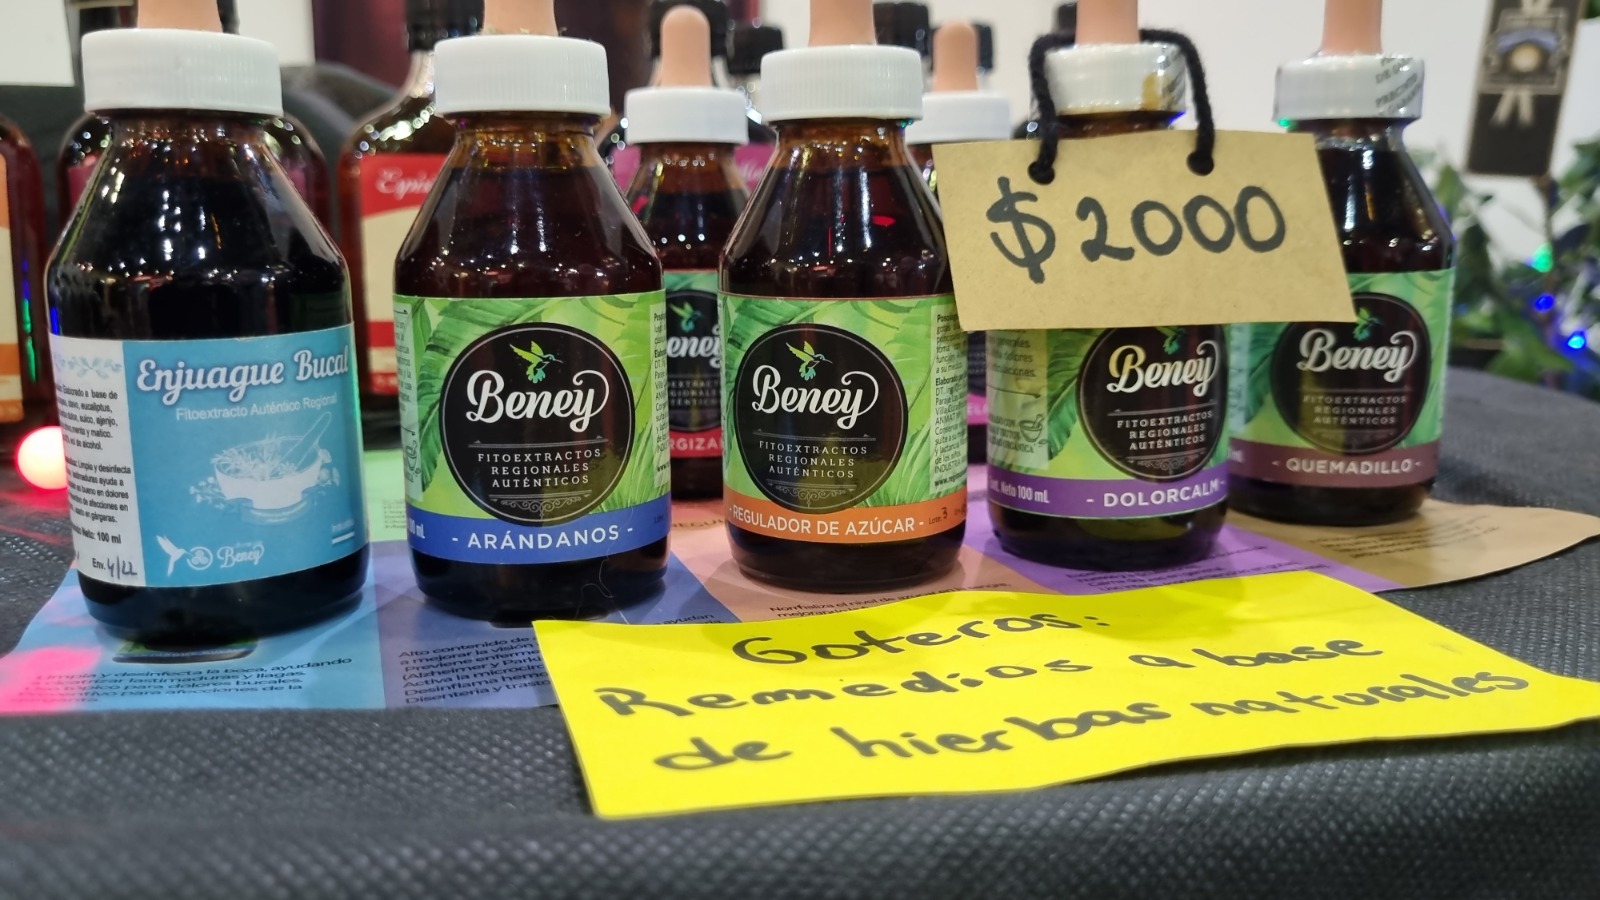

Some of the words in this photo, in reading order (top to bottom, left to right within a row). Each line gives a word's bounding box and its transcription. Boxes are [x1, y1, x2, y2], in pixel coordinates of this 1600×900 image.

[986, 176, 1056, 284] $
[1076, 185, 1286, 262] 2000
[666, 323, 721, 369] eney
[1296, 328, 1417, 383] Beney
[136, 359, 284, 406] Enjuague
[293, 345, 349, 382] Bucal
[1106, 340, 1220, 398] Beney
[91, 389, 107, 399] base
[108, 389, 118, 400] de
[466, 370, 610, 432] Beney
[752, 364, 879, 430] Beney
[1303, 394, 1407, 404] FITOEXTRACTOS
[175, 406, 248, 421] Fitoextracto
[250, 400, 300, 416] Auténtico
[1314, 406, 1397, 415] REGIONALES
[1116, 410, 1213, 429] FITOEXTRACTOS
[1313, 415, 1396, 426] AUTÉNTICOS
[1129, 423, 1206, 440] REGIONALES
[82, 441, 104, 451] alcohol.
[759, 440, 868, 455] FITOEXTRACTOS
[1129, 434, 1206, 451] AUTÉNTICOS
[477, 448, 601, 462] FITOEXTRACTOS
[768, 454, 855, 467] REGIONALES
[98, 464, 132, 475] desinfecta
[491, 462, 590, 475] REGIONALES
[768, 465, 855, 478] AUTÉNTICOS
[1285, 458, 1413, 475] QUEMADILLO
[98, 477, 118, 487] ayuda
[119, 479, 124, 487] a
[492, 475, 590, 488] AUTÉNTICOS
[104, 489, 129, 500] dolores
[1000, 480, 1016, 497] Neto
[1017, 484, 1034, 501] 100
[1034, 488, 1049, 504] mL
[1103, 479, 1219, 508] DOLORCALM
[120, 504, 128, 512] en
[733, 504, 811, 535] REGULADOR
[816, 520, 840, 536] DE
[844, 515, 915, 536] AZÚCAR
[96, 531, 110, 543] 100
[111, 533, 122, 545] ml
[467, 524, 620, 550] ARÁNDANOS
[92, 557, 106, 570] Env.
[216, 544, 265, 569] Beney
[397, 649, 429, 658] Alto
[432, 639, 509, 655] contenido
[412, 650, 473, 666] mejorar
[475, 648, 490, 656] la
[491, 642, 535, 655] visión
[113, 668, 202, 678] desinfecta
[224, 664, 268, 674] boca,
[270, 656, 354, 673] ayudando
[402, 663, 486, 681] (Alzheimer
[488, 662, 500, 670] y
[503, 655, 542, 668] Parki
[404, 659, 469, 673] Previene
[475, 648, 543, 664] enferme
[128, 673, 241, 684] lastimaduras
[256, 670, 306, 681] llagas.
[402, 676, 453, 689] Activa
[456, 672, 470, 680] la
[473, 662, 545, 679] microcirc
[404, 676, 499, 697] Desinflama
[502, 670, 551, 683] hemo
[594, 658, 1093, 717] Remedios
[1129, 654, 1196, 669] a
[1192, 639, 1384, 668] base
[120, 688, 162, 698] para
[169, 684, 259, 696] afecciones
[262, 684, 285, 692] de
[124, 682, 164, 692] para
[168, 678, 232, 690] dolores
[235, 678, 304, 686] bucales.
[506, 678, 551, 691] trasto
[652, 736, 793, 771] de
[829, 702, 1171, 758] hierbas
[1189, 671, 1530, 717] naturales
